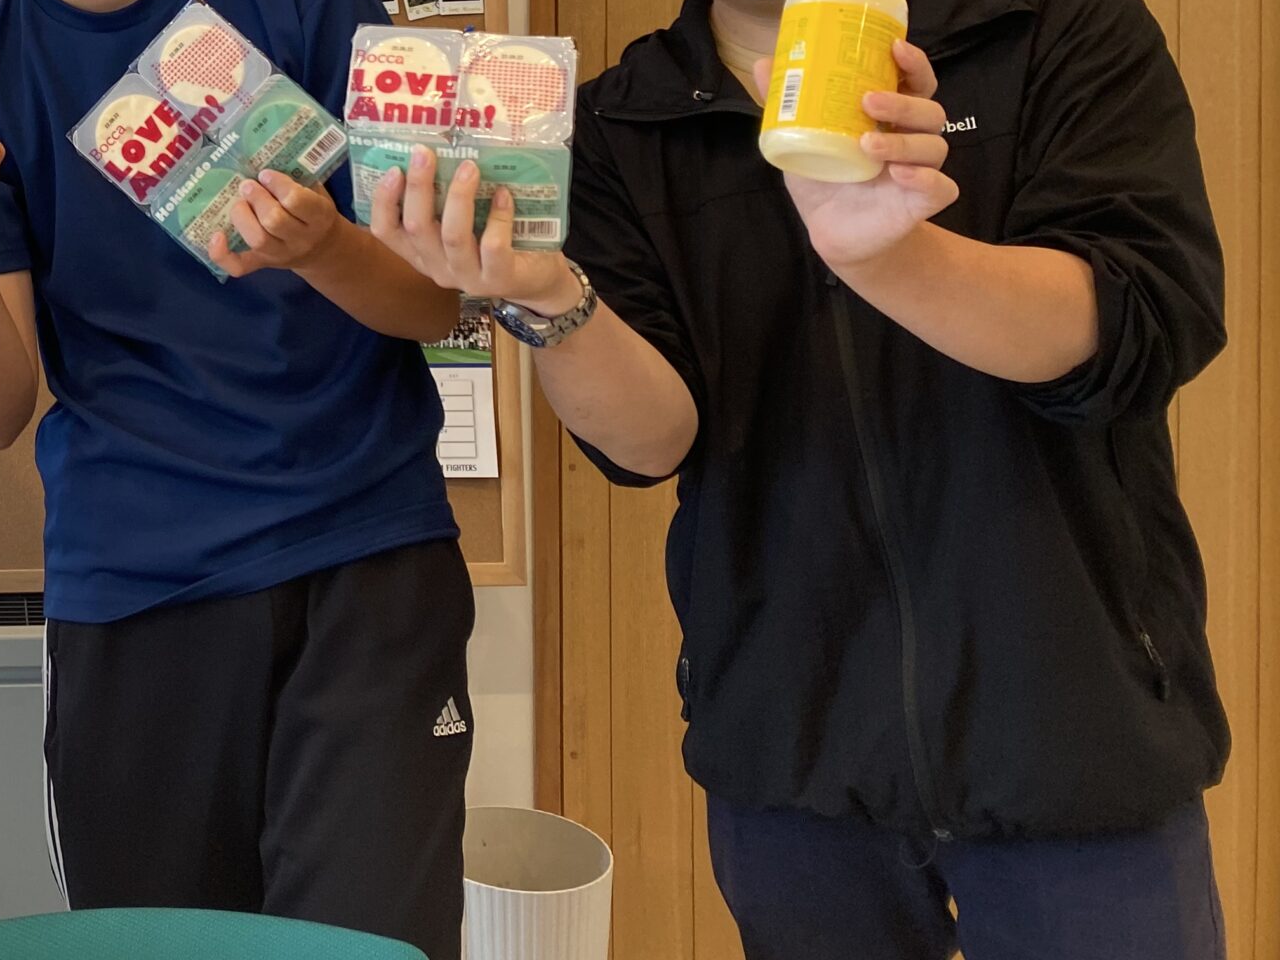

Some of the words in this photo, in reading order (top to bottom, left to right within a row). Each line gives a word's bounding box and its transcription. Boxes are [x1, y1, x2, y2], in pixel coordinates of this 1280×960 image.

[356, 49, 405, 65] Bocca
[351, 68, 459, 99] LOVE
[348, 96, 497, 129] Annin!
[941, 116, 978, 134] bell
[89, 124, 127, 163] Bocca
[104, 98, 183, 184] LOVE
[129, 94, 225, 202] Annin!
[155, 161, 212, 222] Hokkaido
[210, 131, 241, 163] milk
[446, 464, 478, 472] FIGHTERS
[433, 720, 467, 737] adidas
